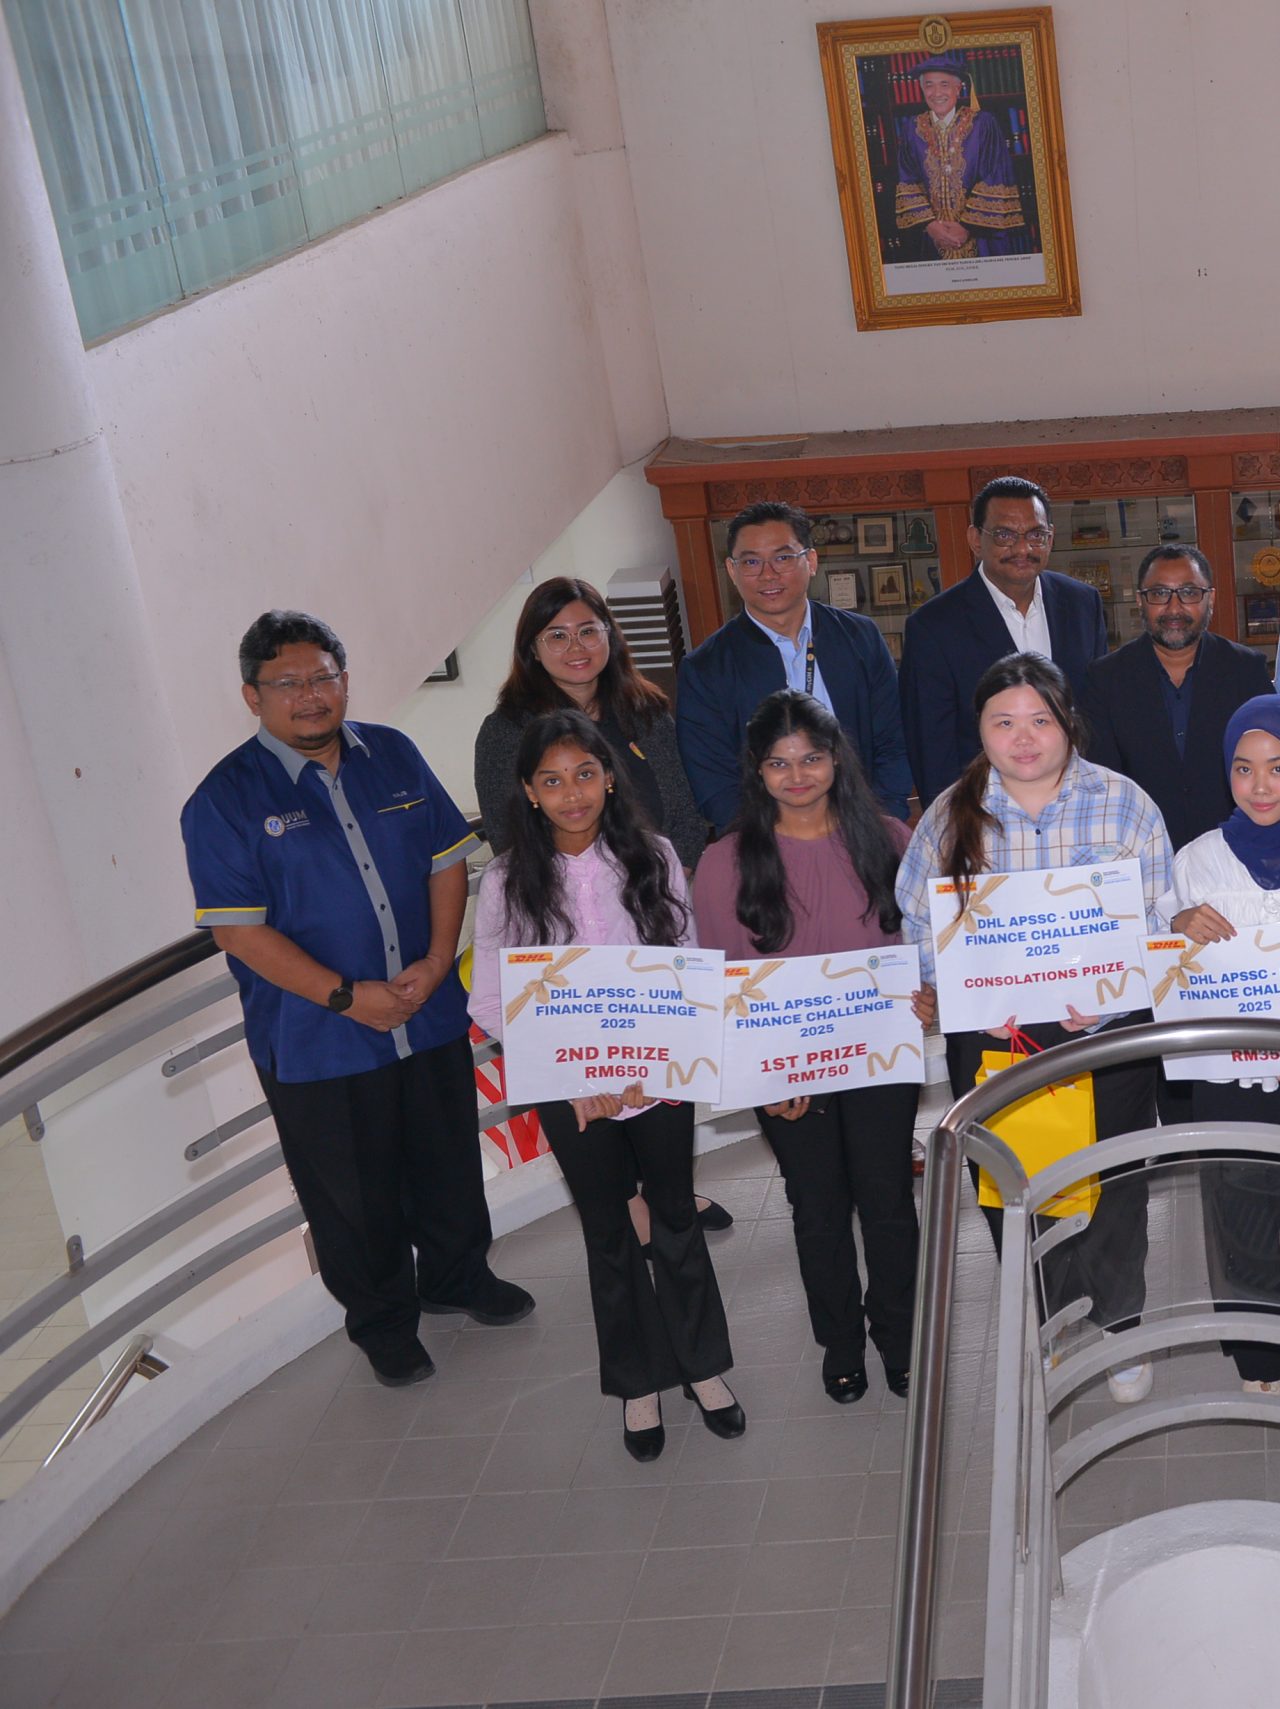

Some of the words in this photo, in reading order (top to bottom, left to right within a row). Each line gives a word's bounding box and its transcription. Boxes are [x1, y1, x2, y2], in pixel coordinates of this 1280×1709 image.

[280, 809, 308, 824] UUM
[978, 918, 1005, 929] DHL
[1008, 913, 1057, 927] APSSC
[1069, 906, 1104, 921] UUM
[965, 931, 1027, 946] FINANCE
[1031, 920, 1120, 940] CHALLENGE
[1025, 944, 1060, 957] 2025
[964, 968, 1078, 989] CONSOLATIONS
[1082, 961, 1125, 977] PRIZE
[1189, 975, 1217, 986] DHL
[1221, 969, 1268, 983] APSSC
[550, 989, 581, 1000] DHL
[586, 988, 636, 999] APSSC
[649, 989, 682, 1000] UUM
[750, 1001, 780, 1013] DHL
[784, 995, 833, 1010] APSSC
[845, 987, 879, 1002] UUM
[1179, 987, 1239, 1001] FINANCE
[536, 1003, 603, 1017] FINANCE
[608, 1003, 697, 1017] CHALLENGE
[736, 1014, 802, 1029] FINANCE
[806, 999, 894, 1024] CHALLENGE
[1238, 1000, 1272, 1013] 2025
[600, 1018, 636, 1029] 2025
[800, 1023, 834, 1037] 2025
[555, 1046, 600, 1063] 2ND
[607, 1046, 670, 1062] PRIZE
[761, 1055, 799, 1073] 1ST
[807, 1043, 867, 1065] PRIZE
[585, 1065, 649, 1079] RM650
[788, 1064, 849, 1084] RM750
